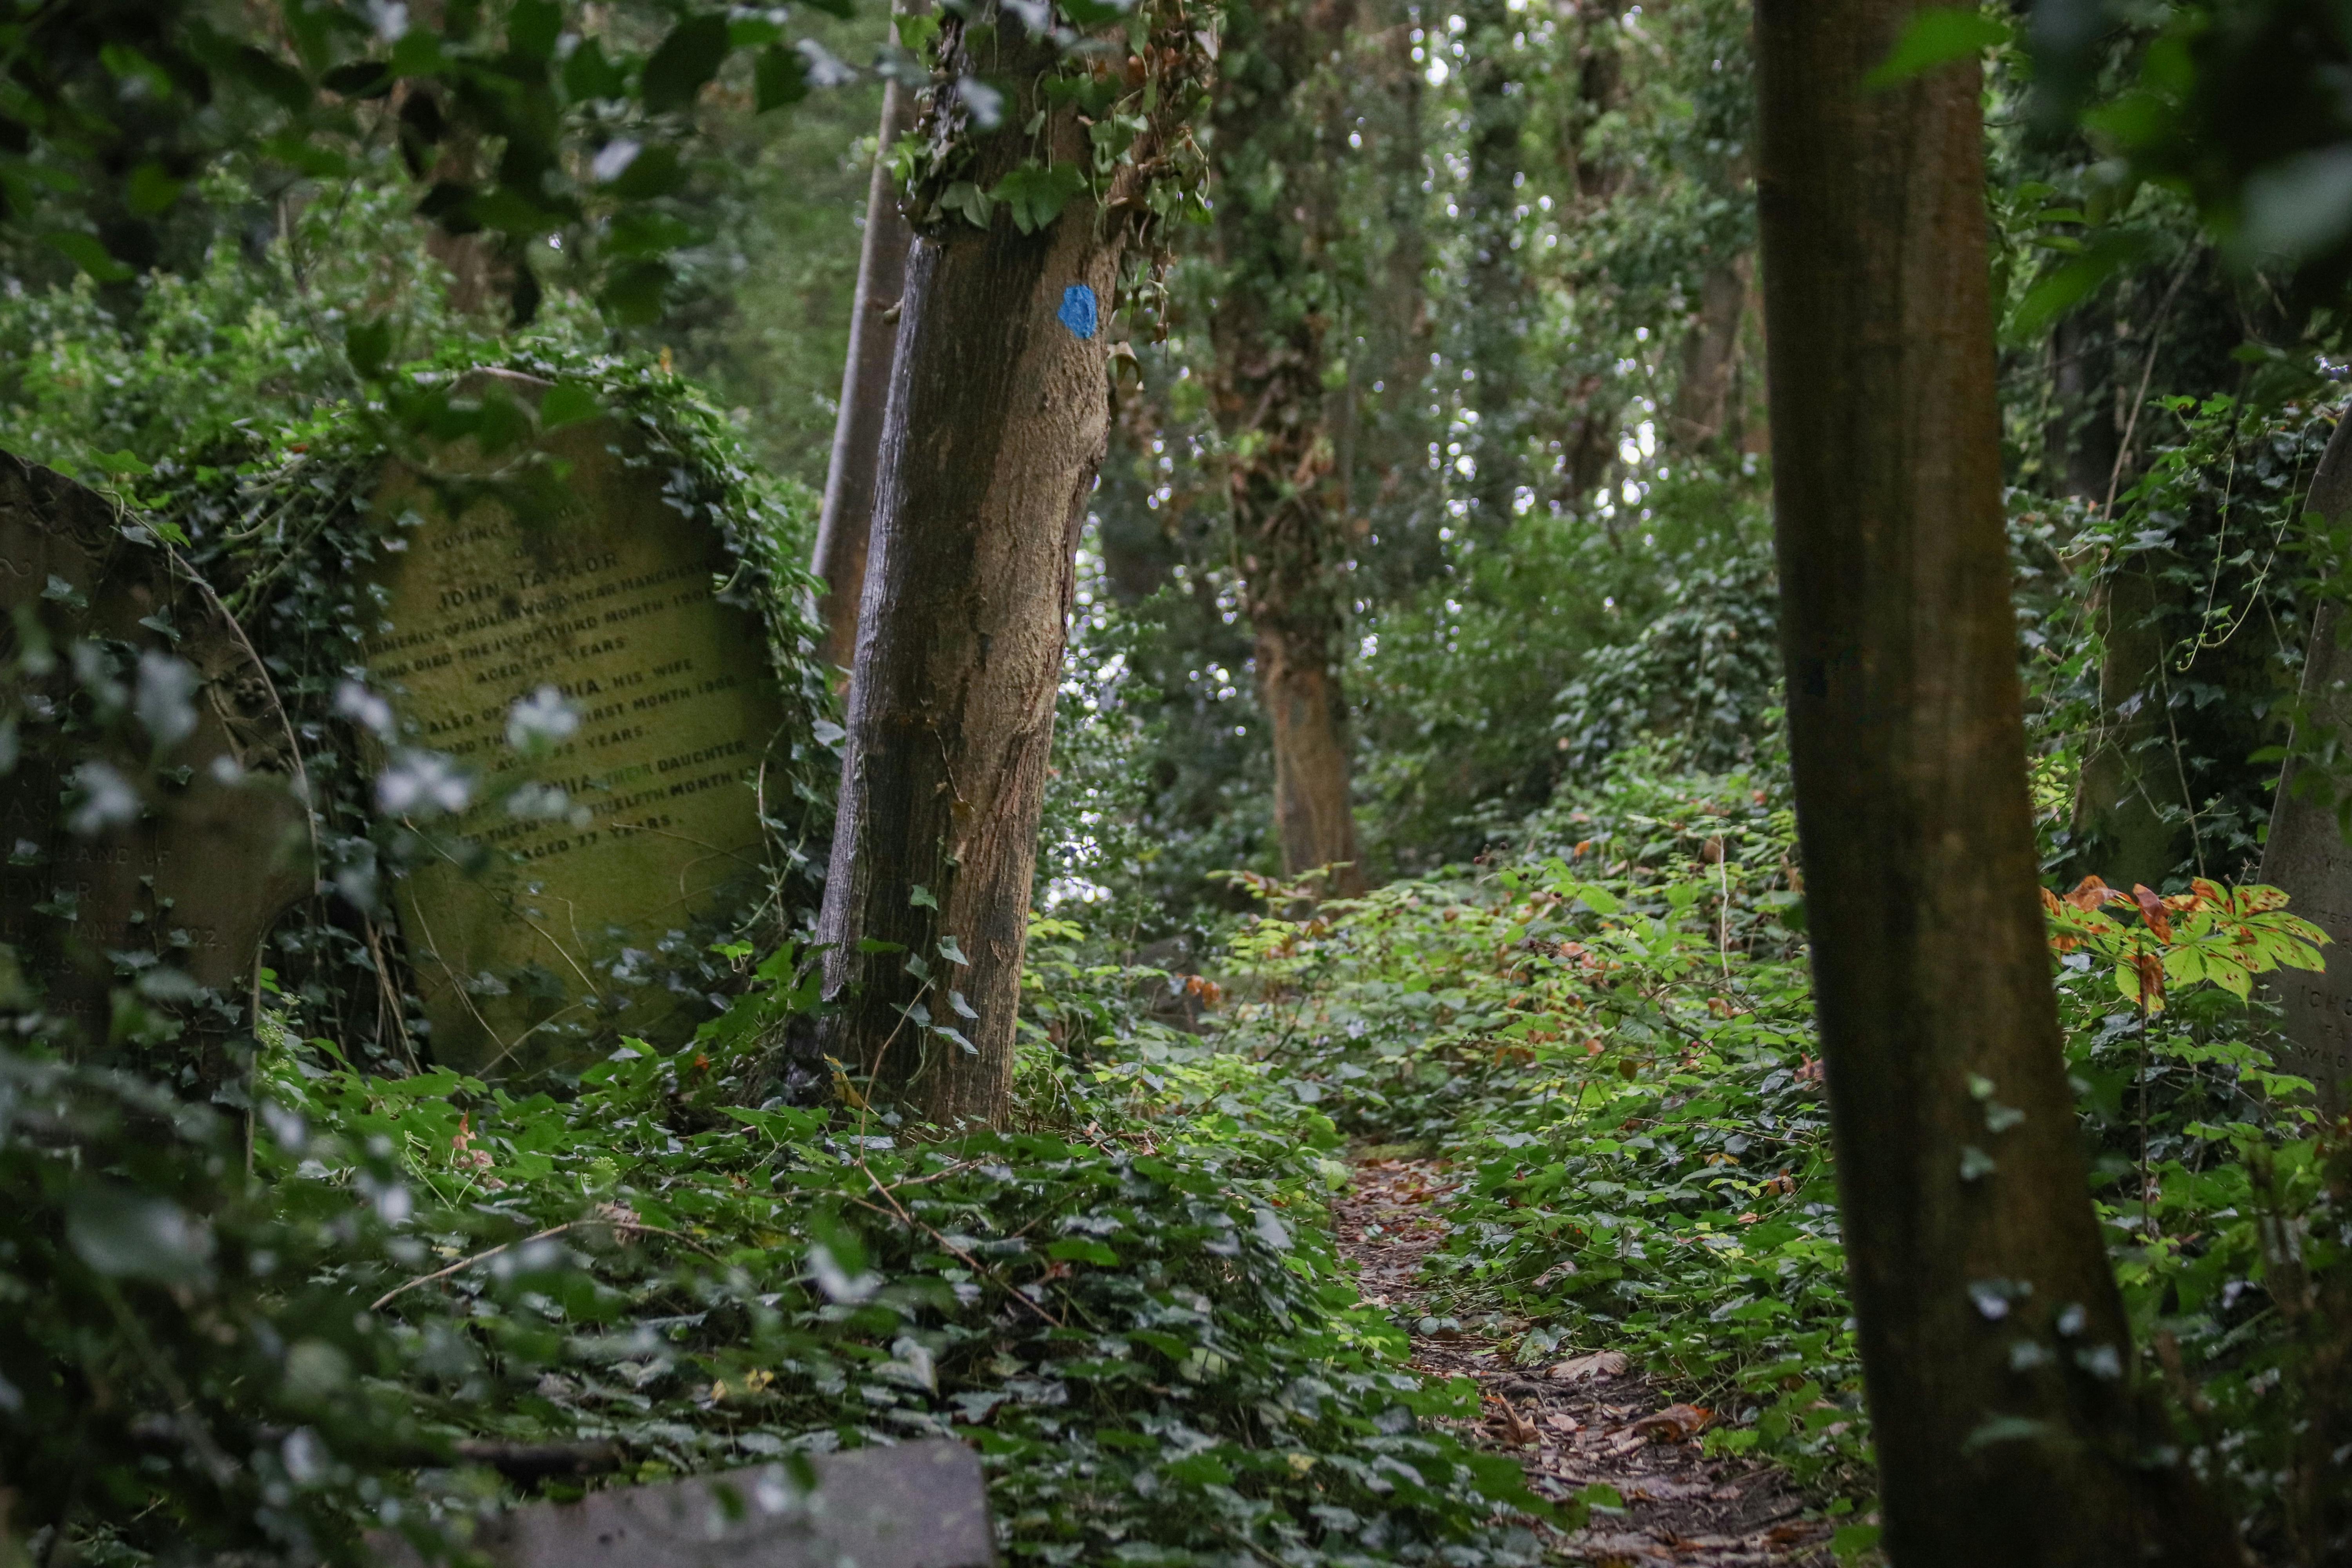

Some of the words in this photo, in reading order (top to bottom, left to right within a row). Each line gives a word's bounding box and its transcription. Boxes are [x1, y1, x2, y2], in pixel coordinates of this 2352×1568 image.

[437, 582, 500, 612] JOHN
[515, 552, 618, 589] TAYLOR
[413, 652, 453, 672] DIED
[459, 642, 490, 661] THE
[604, 599, 664, 624] MONTH
[444, 622, 461, 638] OF
[574, 583, 617, 604] NEAR
[475, 662, 521, 685] AGED
[566, 636, 627, 663] YEARS
[429, 713, 474, 736] ALSO
[481, 706, 501, 722] OF
[612, 670, 644, 689] HIS
[652, 658, 693, 678] WIFE
[632, 687, 691, 711] MONTH
[657, 739, 746, 774] DAUGHTER
[668, 772, 732, 798] MONTH
